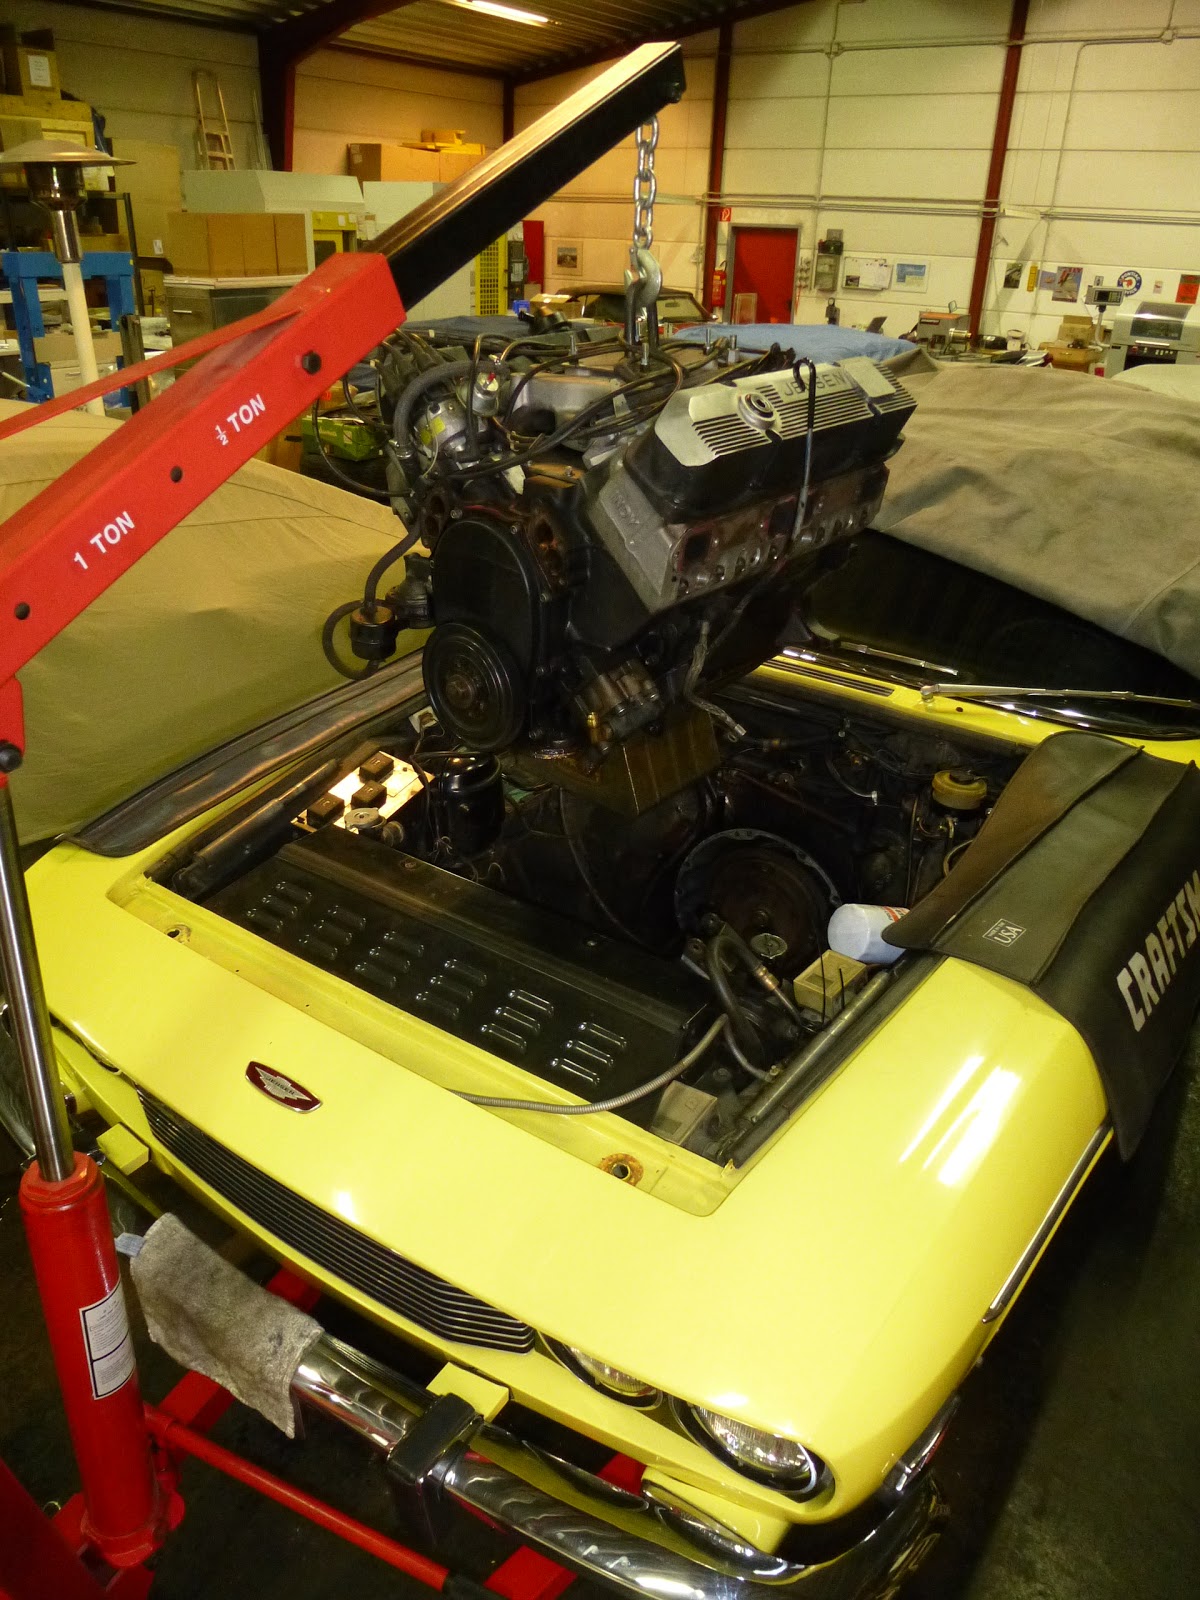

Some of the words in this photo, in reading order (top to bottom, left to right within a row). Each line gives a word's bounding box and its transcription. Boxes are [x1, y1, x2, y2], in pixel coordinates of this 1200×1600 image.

[227, 393, 266, 432] TON
[74, 552, 88, 570] 1
[90, 511, 135, 553] TON
[993, 926, 1022, 943] USA
